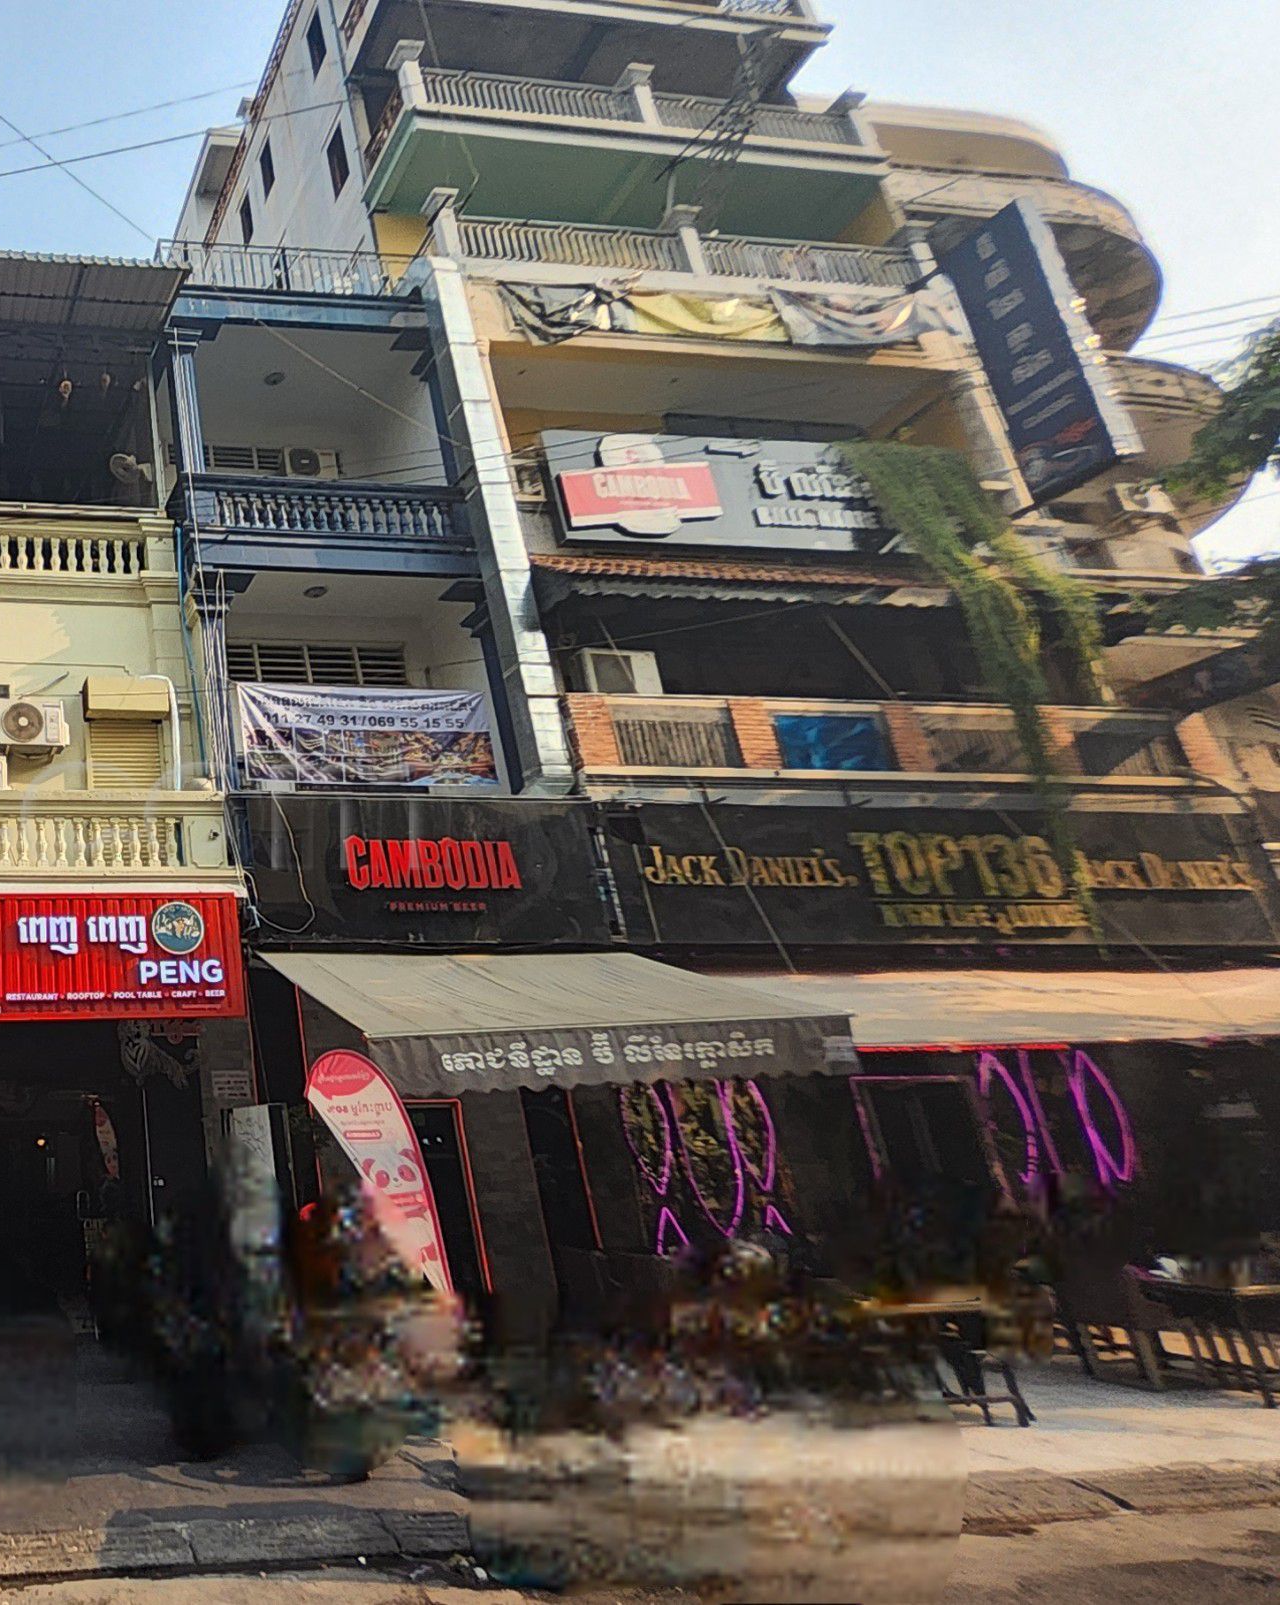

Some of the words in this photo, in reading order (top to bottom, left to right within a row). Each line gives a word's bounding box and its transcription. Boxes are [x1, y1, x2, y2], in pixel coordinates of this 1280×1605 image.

[317, 714, 336, 727] 49
[400, 717, 419, 728] 55
[423, 717, 441, 729] 15
[445, 718, 465, 729] 55
[344, 834, 522, 891] CAMBODIA
[645, 845, 726, 886] JACK
[139, 959, 224, 985] PENG
[6, 992, 59, 1001] RESTAURANT
[66, 992, 105, 1000] ROOFTOP
[113, 991, 136, 1000] POOL
[137, 991, 163, 999] TABLE
